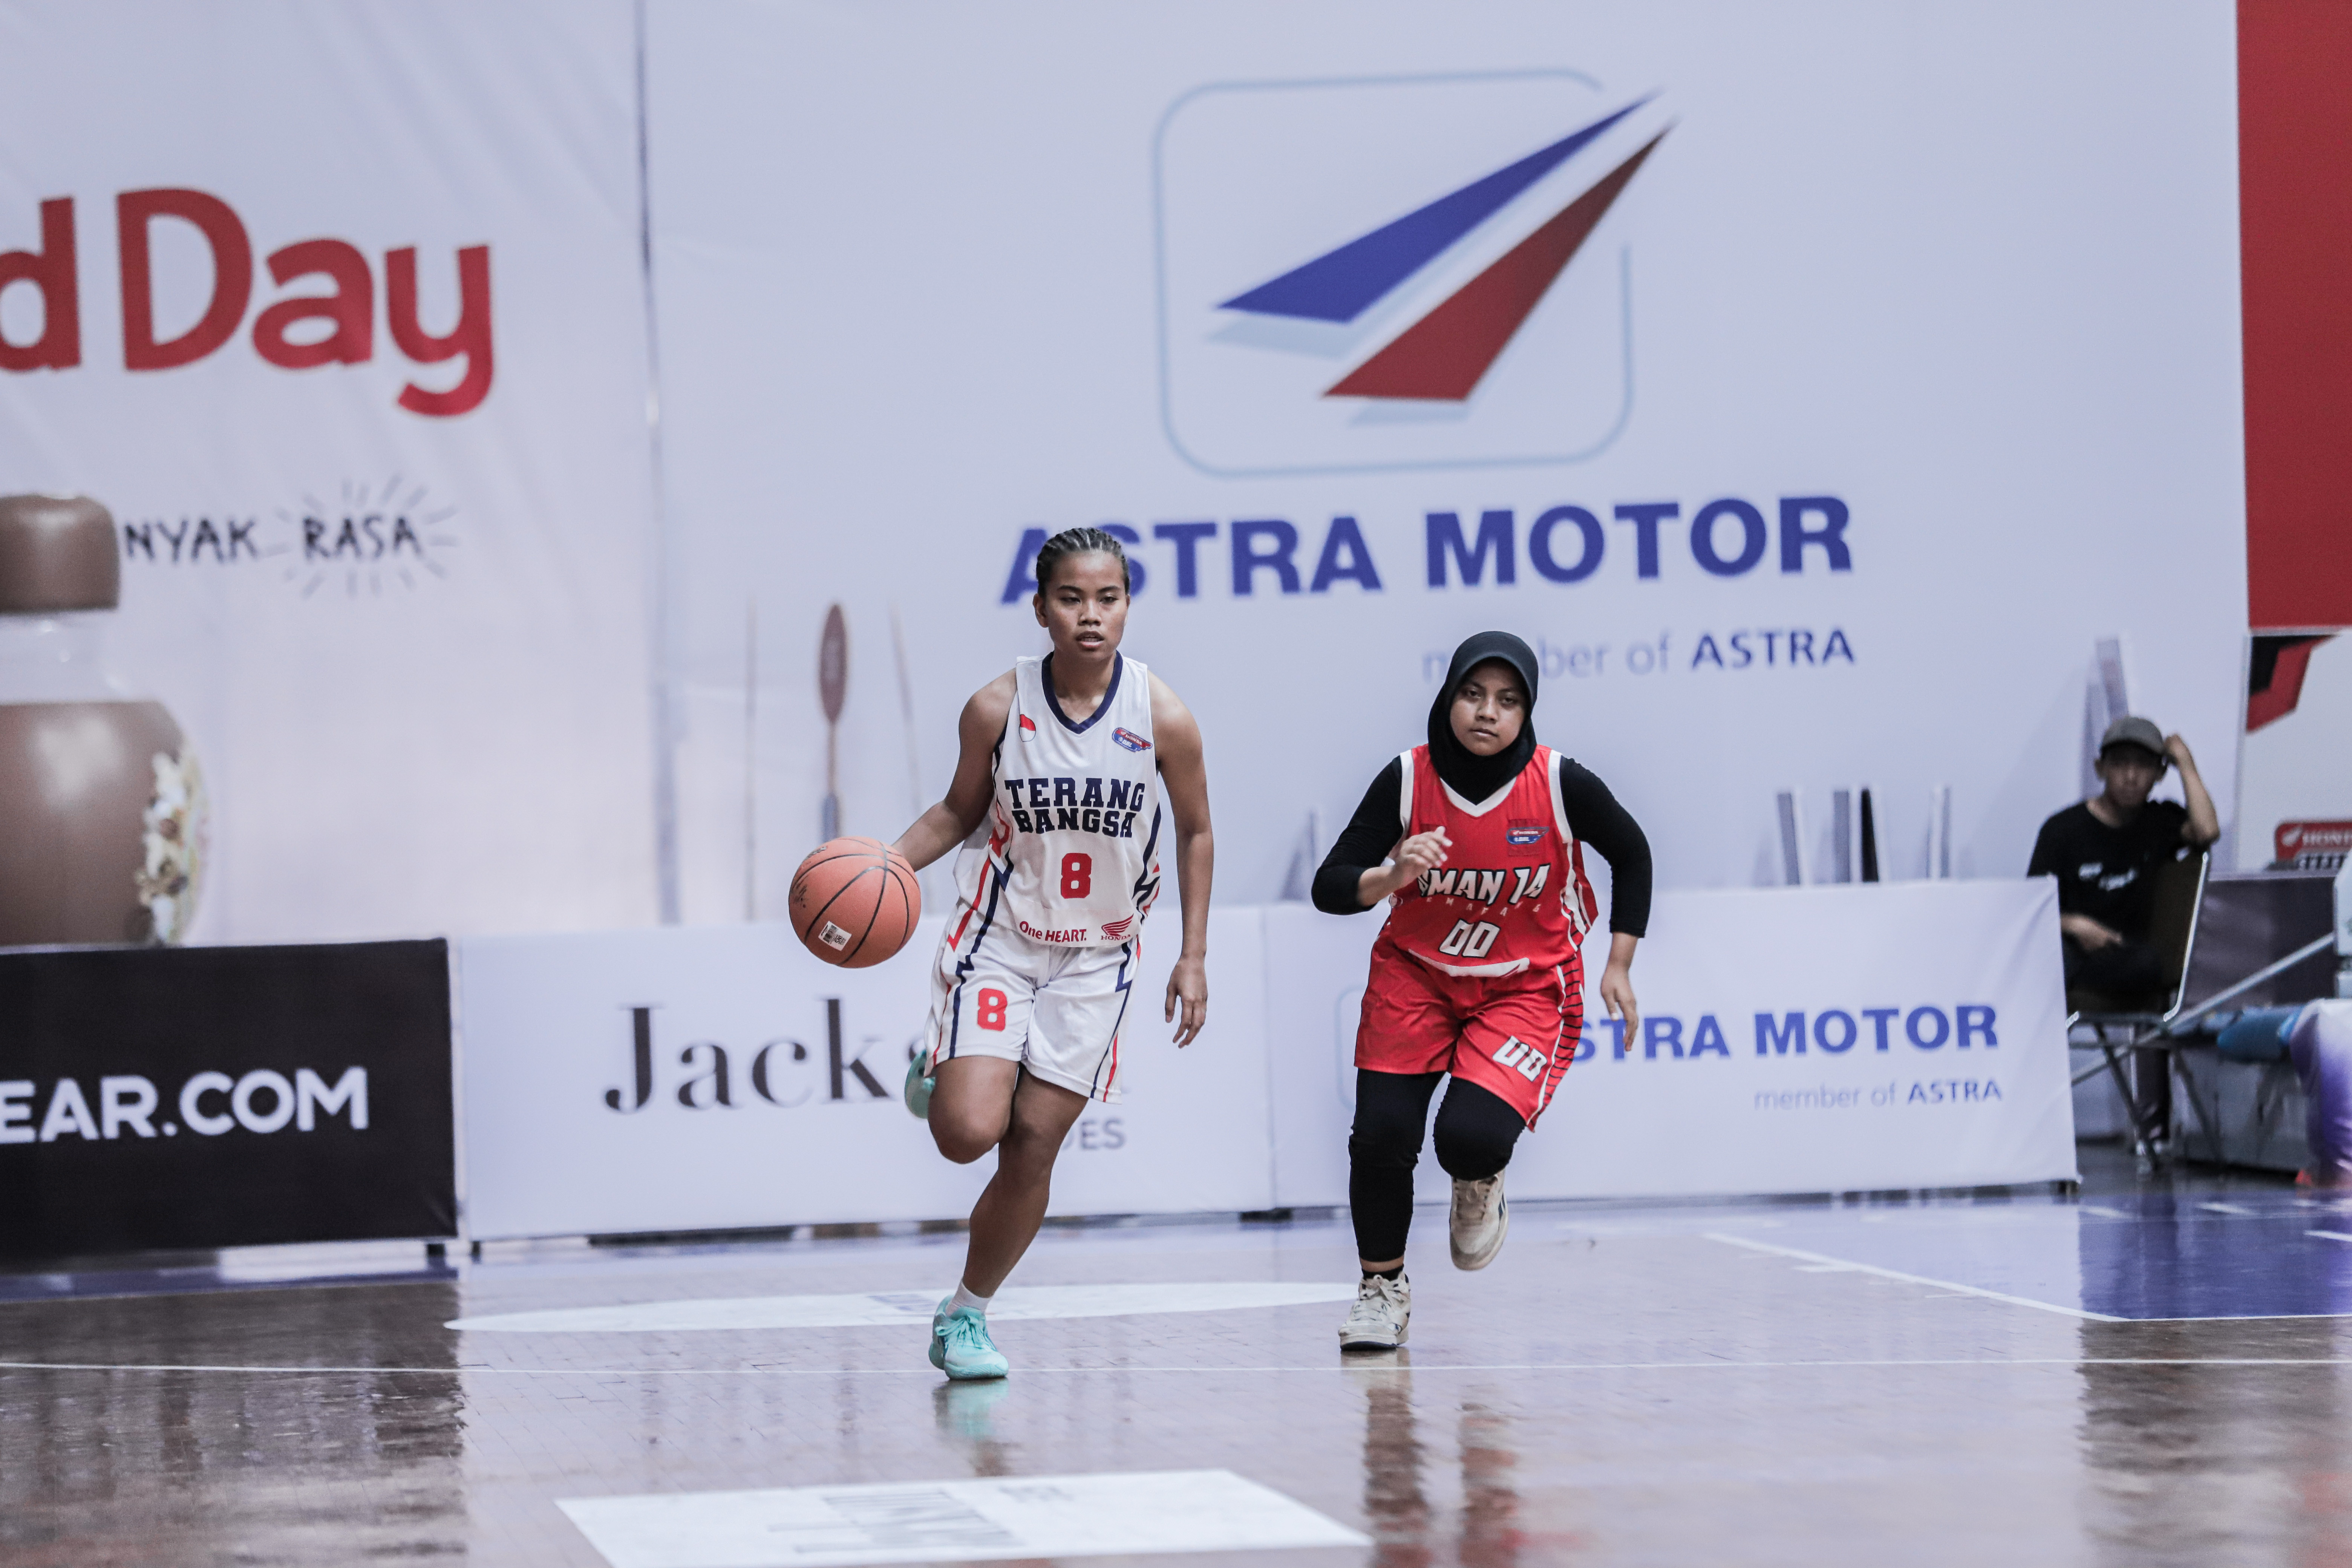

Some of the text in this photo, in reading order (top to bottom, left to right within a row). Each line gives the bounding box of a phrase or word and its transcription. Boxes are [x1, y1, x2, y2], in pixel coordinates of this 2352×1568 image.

[0, 187, 494, 417] d Day
[125, 516, 422, 564] NYAK RASA
[1425, 496, 1852, 588] MOTOR
[1625, 632, 1670, 675] of
[1692, 627, 1855, 671] ASTRA
[1125, 734, 1142, 746] HONDA
[1004, 778, 1145, 812] TERANG
[1012, 808, 1137, 838] BANGSA
[1060, 853, 1092, 899] 8
[1508, 863, 1551, 905] 14
[1020, 921, 1087, 943] One HEART.
[1438, 918, 1501, 958] 00
[977, 988, 1008, 1031] 8
[1754, 1005, 1998, 1057] MOTOR
[605, 996, 924, 1115] Jack
[1492, 1035, 1548, 1082] 00
[0, 1066, 369, 1144] EAR.COM
[1754, 1078, 2002, 1110] member of ASTRA
